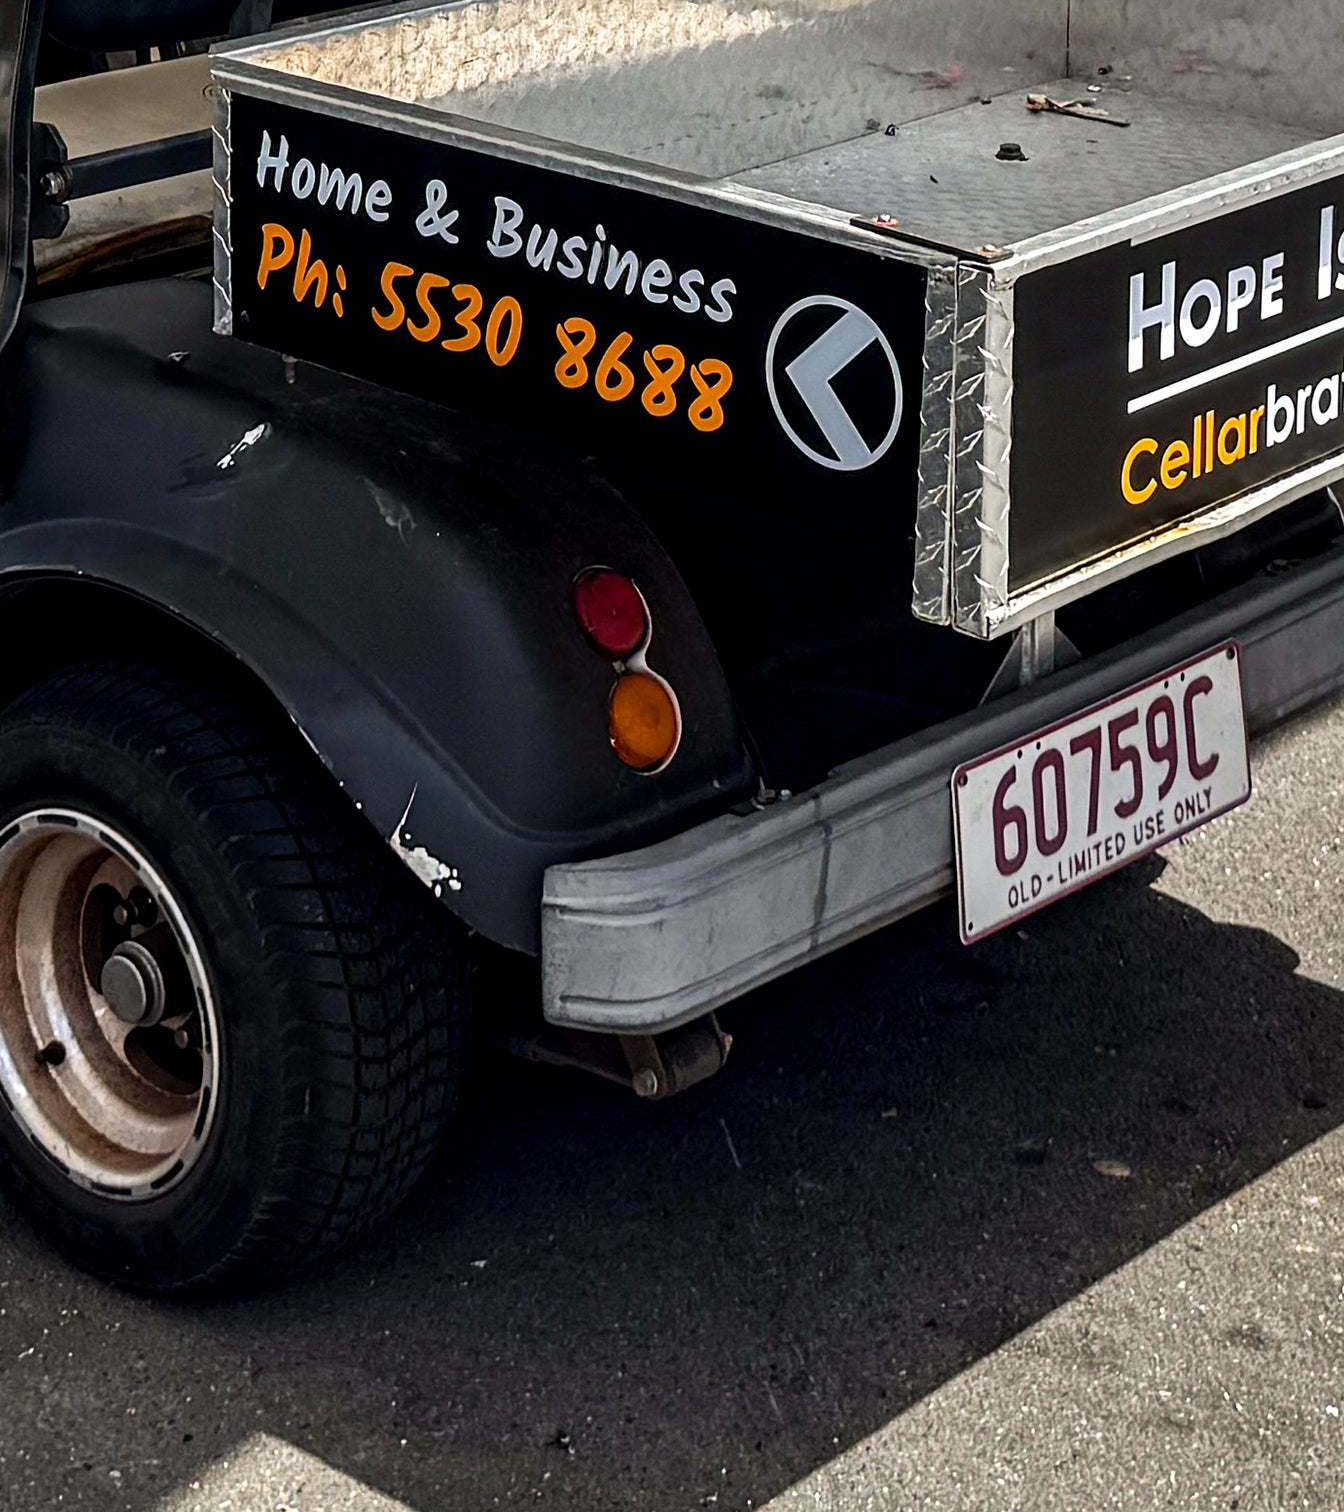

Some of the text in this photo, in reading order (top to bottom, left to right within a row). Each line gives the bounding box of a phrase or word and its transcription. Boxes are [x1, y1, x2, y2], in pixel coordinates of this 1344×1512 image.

[255, 129, 738, 324] Home & Business
[1127, 249, 1286, 374] HOPE
[256, 222, 733, 433] Ph: 5530 8688
[991, 674, 1220, 878] 60759C
[1133, 809, 1166, 845] USE
[1173, 787, 1214, 825] ONLY
